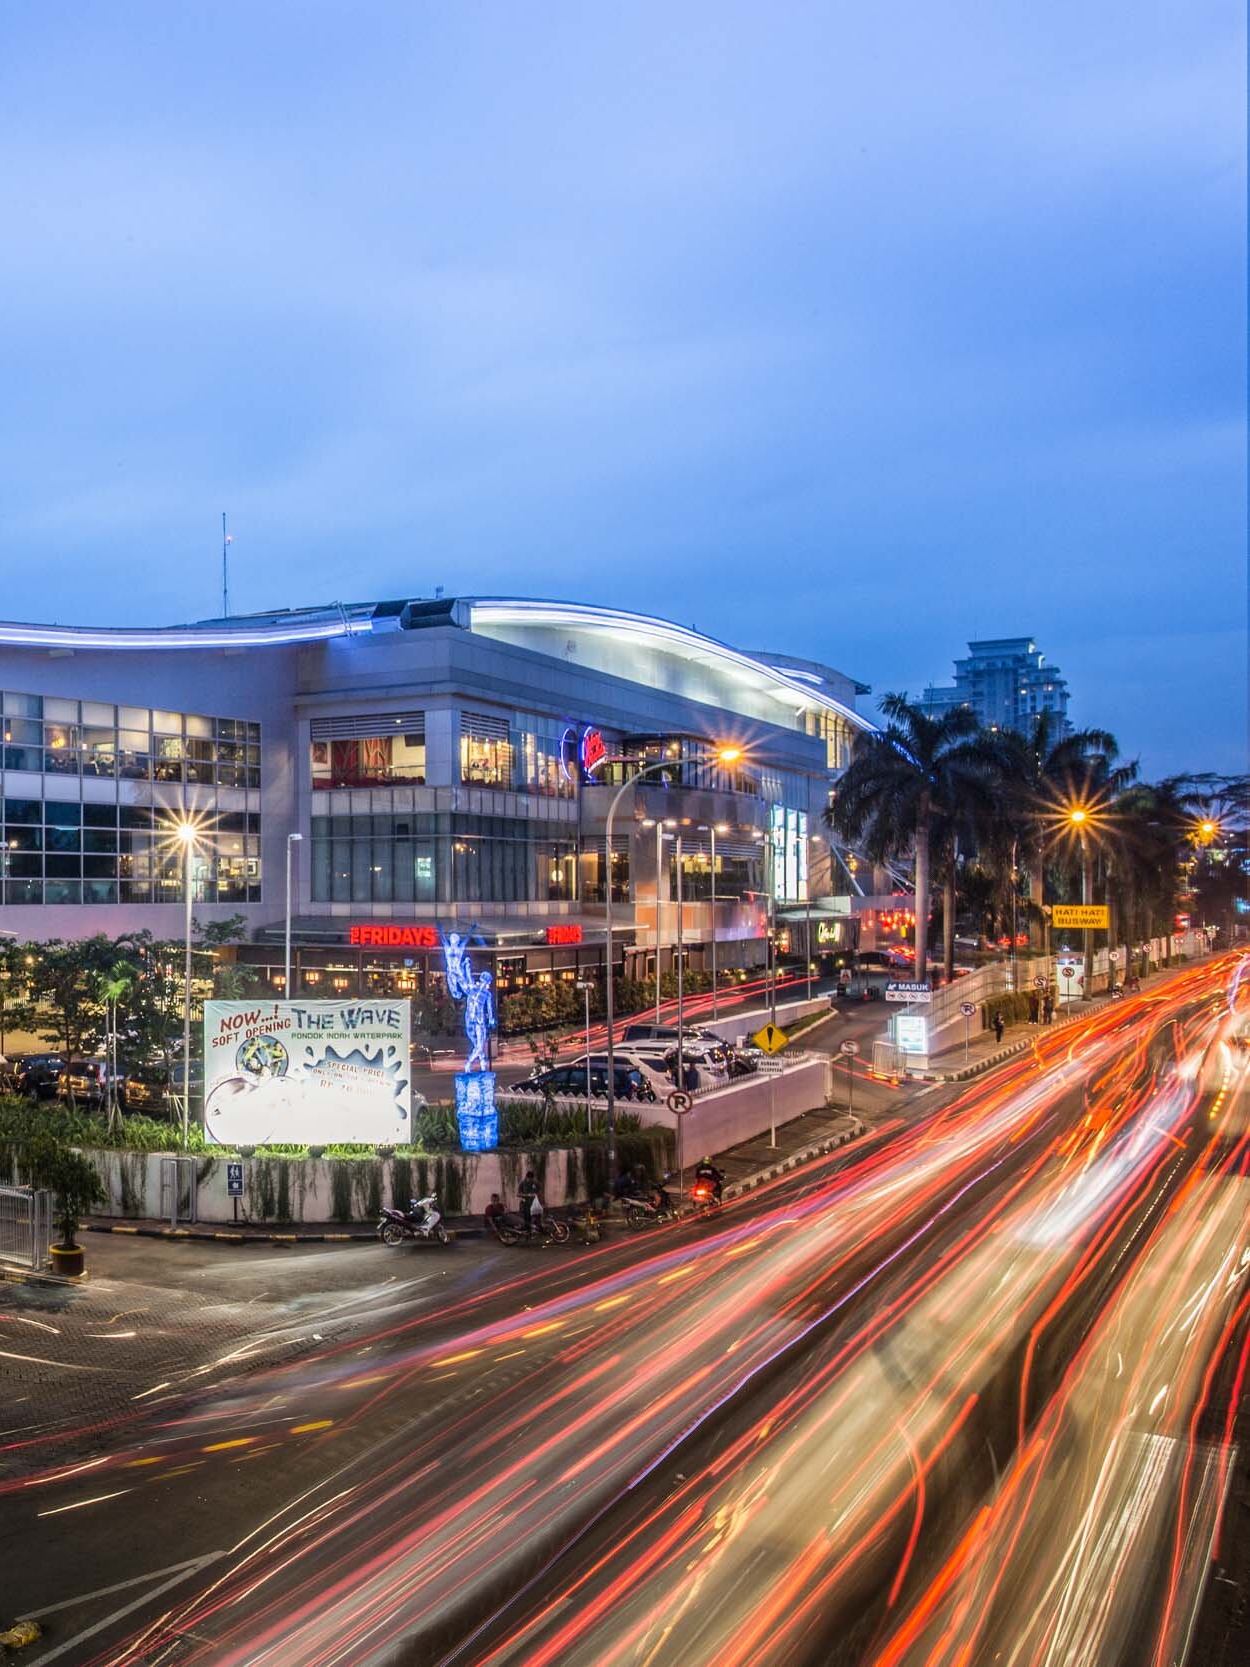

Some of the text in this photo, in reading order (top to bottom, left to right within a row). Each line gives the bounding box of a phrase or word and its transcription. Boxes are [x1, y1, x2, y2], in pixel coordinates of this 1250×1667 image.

[360, 927, 436, 945] FRIDAYS
[898, 983, 929, 991] MASUK
[290, 1007, 401, 1030] THE WAVE
[212, 1018, 292, 1048] SOFT OPENING
[291, 1032, 403, 1040] PONDOK INDAH WATERPARK
